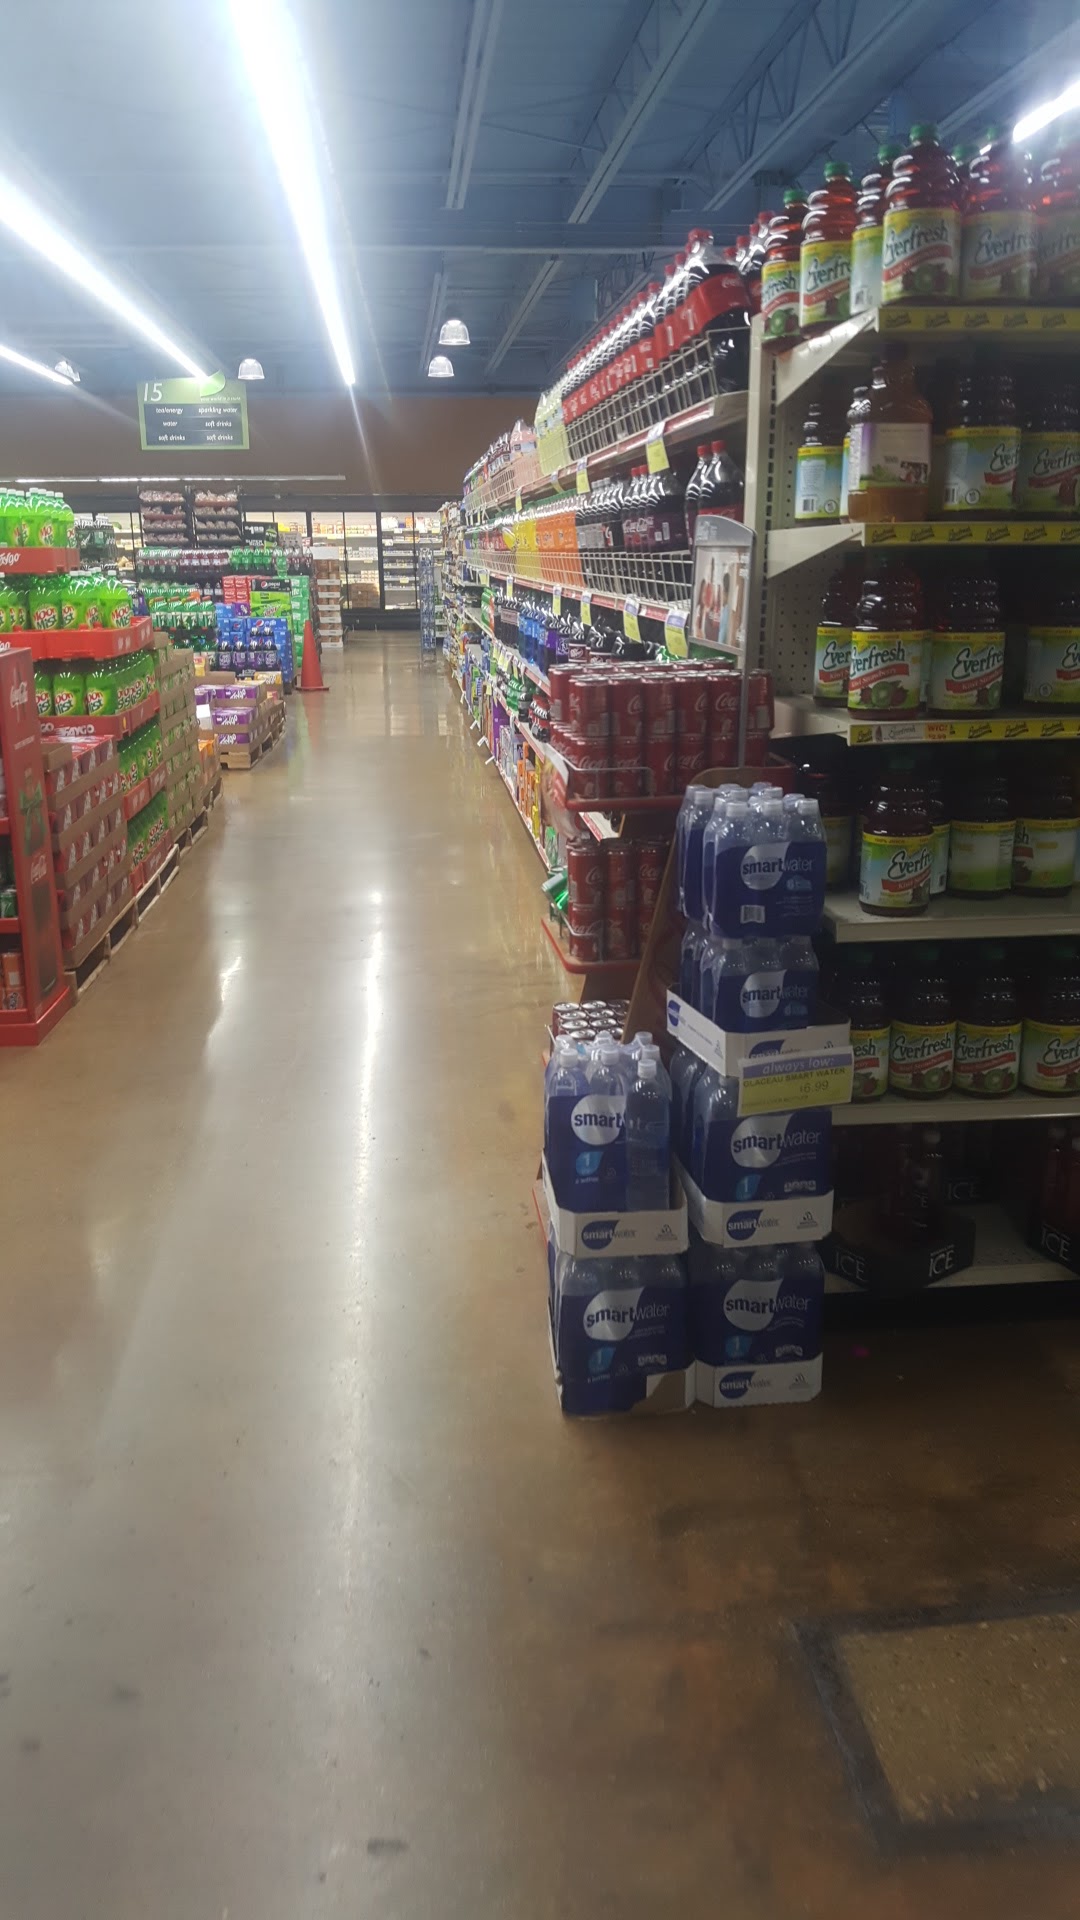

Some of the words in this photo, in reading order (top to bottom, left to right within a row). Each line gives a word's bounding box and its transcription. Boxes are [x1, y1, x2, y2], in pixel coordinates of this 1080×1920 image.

[143, 382, 164, 403] 15
[198, 406, 222, 415] sparkling
[205, 420, 215, 428] soft
[158, 434, 169, 442] soft
[206, 434, 216, 442] soft
[741, 856, 815, 876] smartwater
[741, 984, 811, 1004] smartwater
[892, 1031, 953, 1062] Everfresh
[954, 1033, 1015, 1061] Everfresh
[762, 1060, 805, 1076] always
[808, 1056, 835, 1068] low:
[743, 1076, 784, 1088] GLACEAU
[785, 1071, 814, 1082] SMART
[816, 1067, 846, 1077] WATER
[732, 1128, 823, 1154] smartwater
[727, 1215, 781, 1232] smartwater
[582, 1227, 638, 1242] smartwater
[1041, 1225, 1072, 1262] ICE
[834, 1250, 870, 1284] ICE
[928, 1245, 956, 1278] ICE
[725, 1292, 813, 1315] smartwater
[585, 1302, 671, 1329] smartwater
